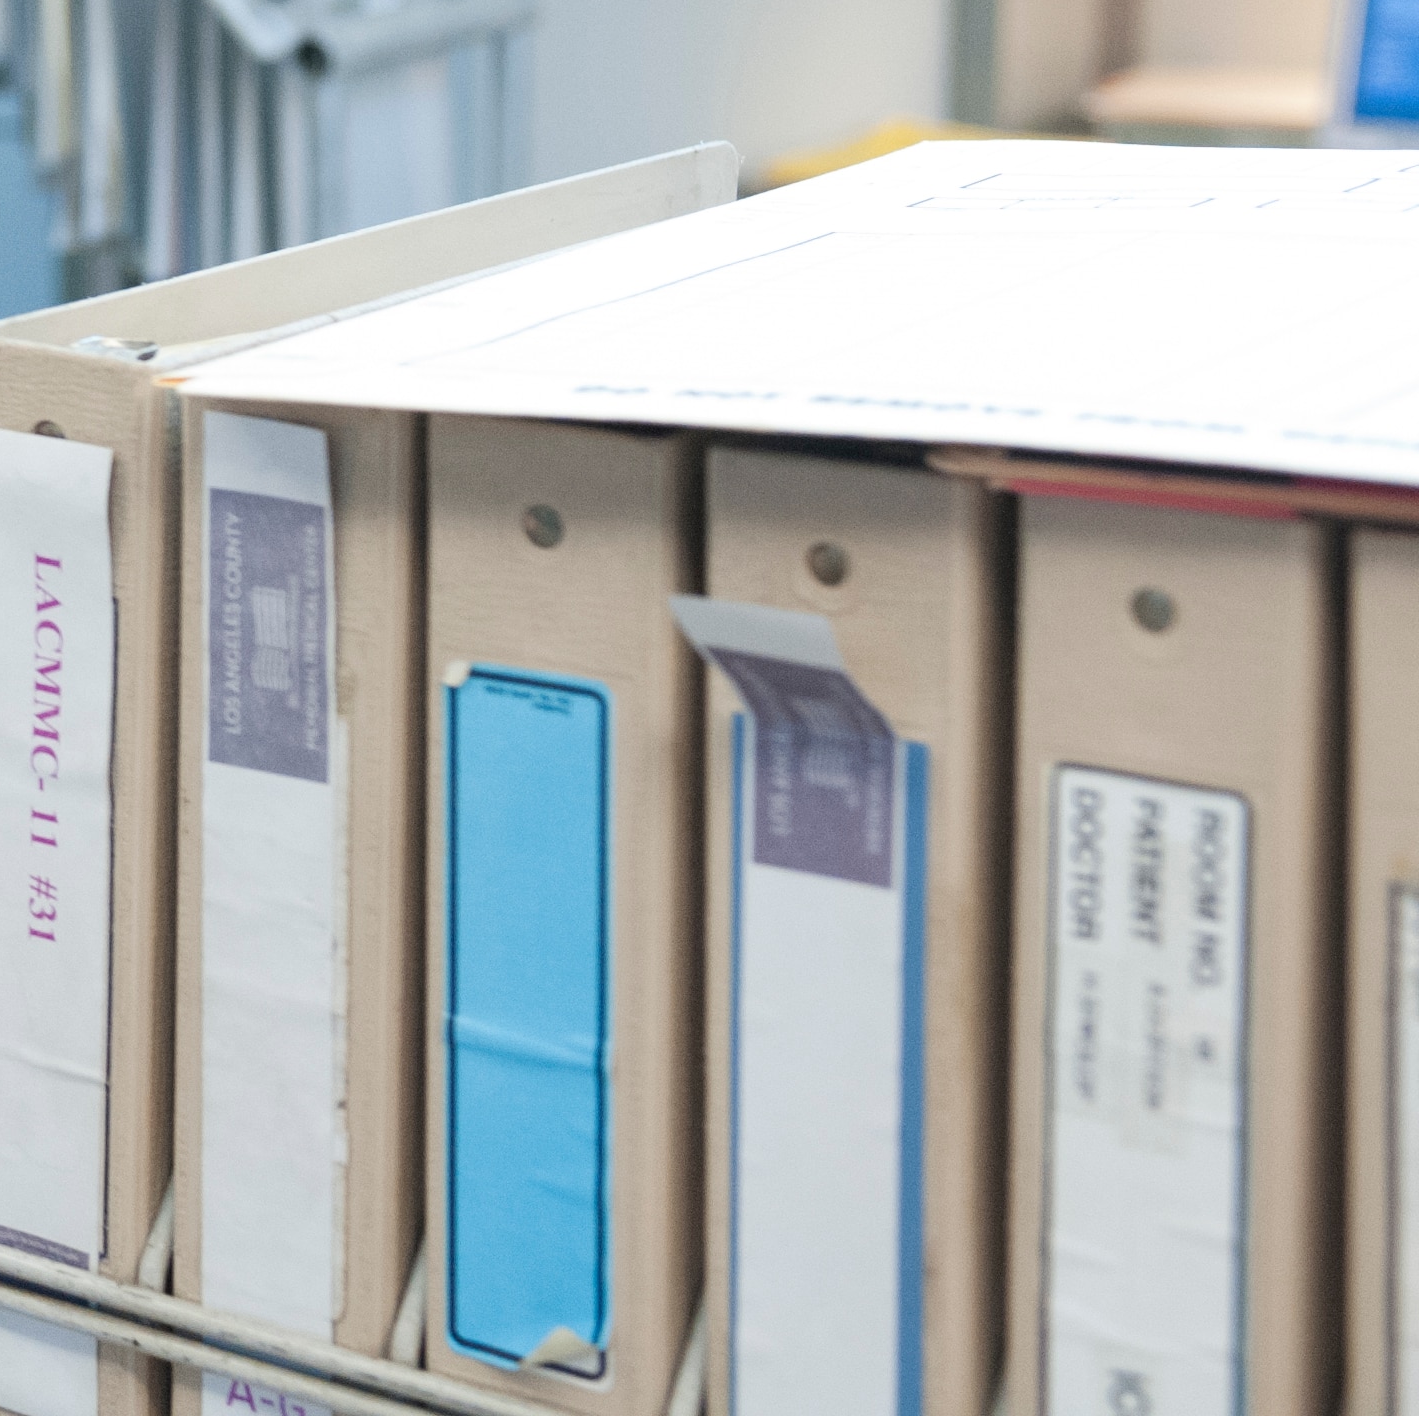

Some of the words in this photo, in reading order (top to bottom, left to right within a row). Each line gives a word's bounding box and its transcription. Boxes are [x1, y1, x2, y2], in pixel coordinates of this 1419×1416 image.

[223, 510, 243, 601] COUNTY
[222, 602, 242, 693] ANGELES
[222, 694, 242, 734] LOS
[1068, 787, 1102, 940] DOCTOR
[1130, 796, 1163, 945] PATIENT
[1191, 808, 1222, 921] ROOM
